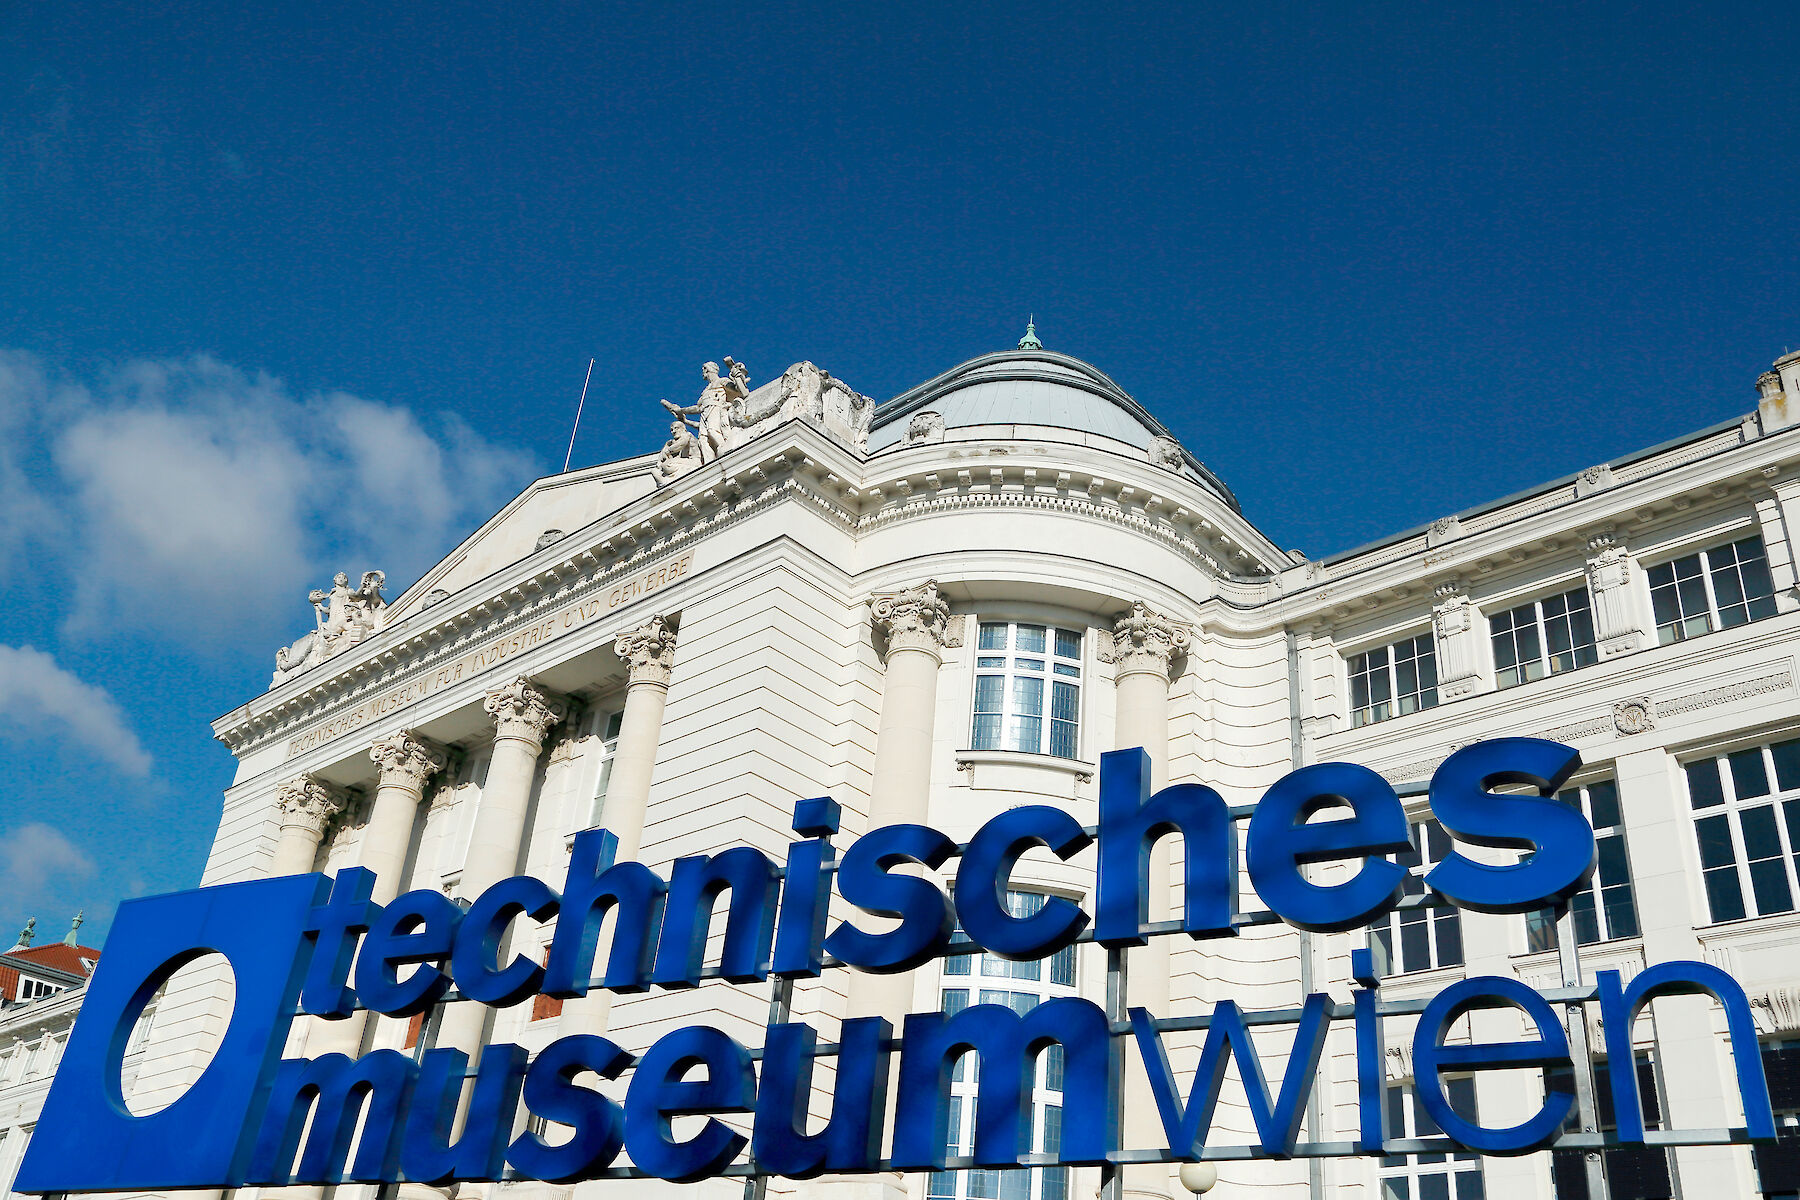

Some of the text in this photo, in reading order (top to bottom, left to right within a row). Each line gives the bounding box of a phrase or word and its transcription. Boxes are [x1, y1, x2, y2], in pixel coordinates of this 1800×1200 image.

[288, 709, 364, 757] TECHNISCHES
[371, 681, 429, 717] MUSEUM
[471, 619, 555, 672] INDUSTRIE
[564, 599, 601, 628] UND
[608, 556, 690, 609] GEWERBE
[302, 736, 1597, 1021] technisches
